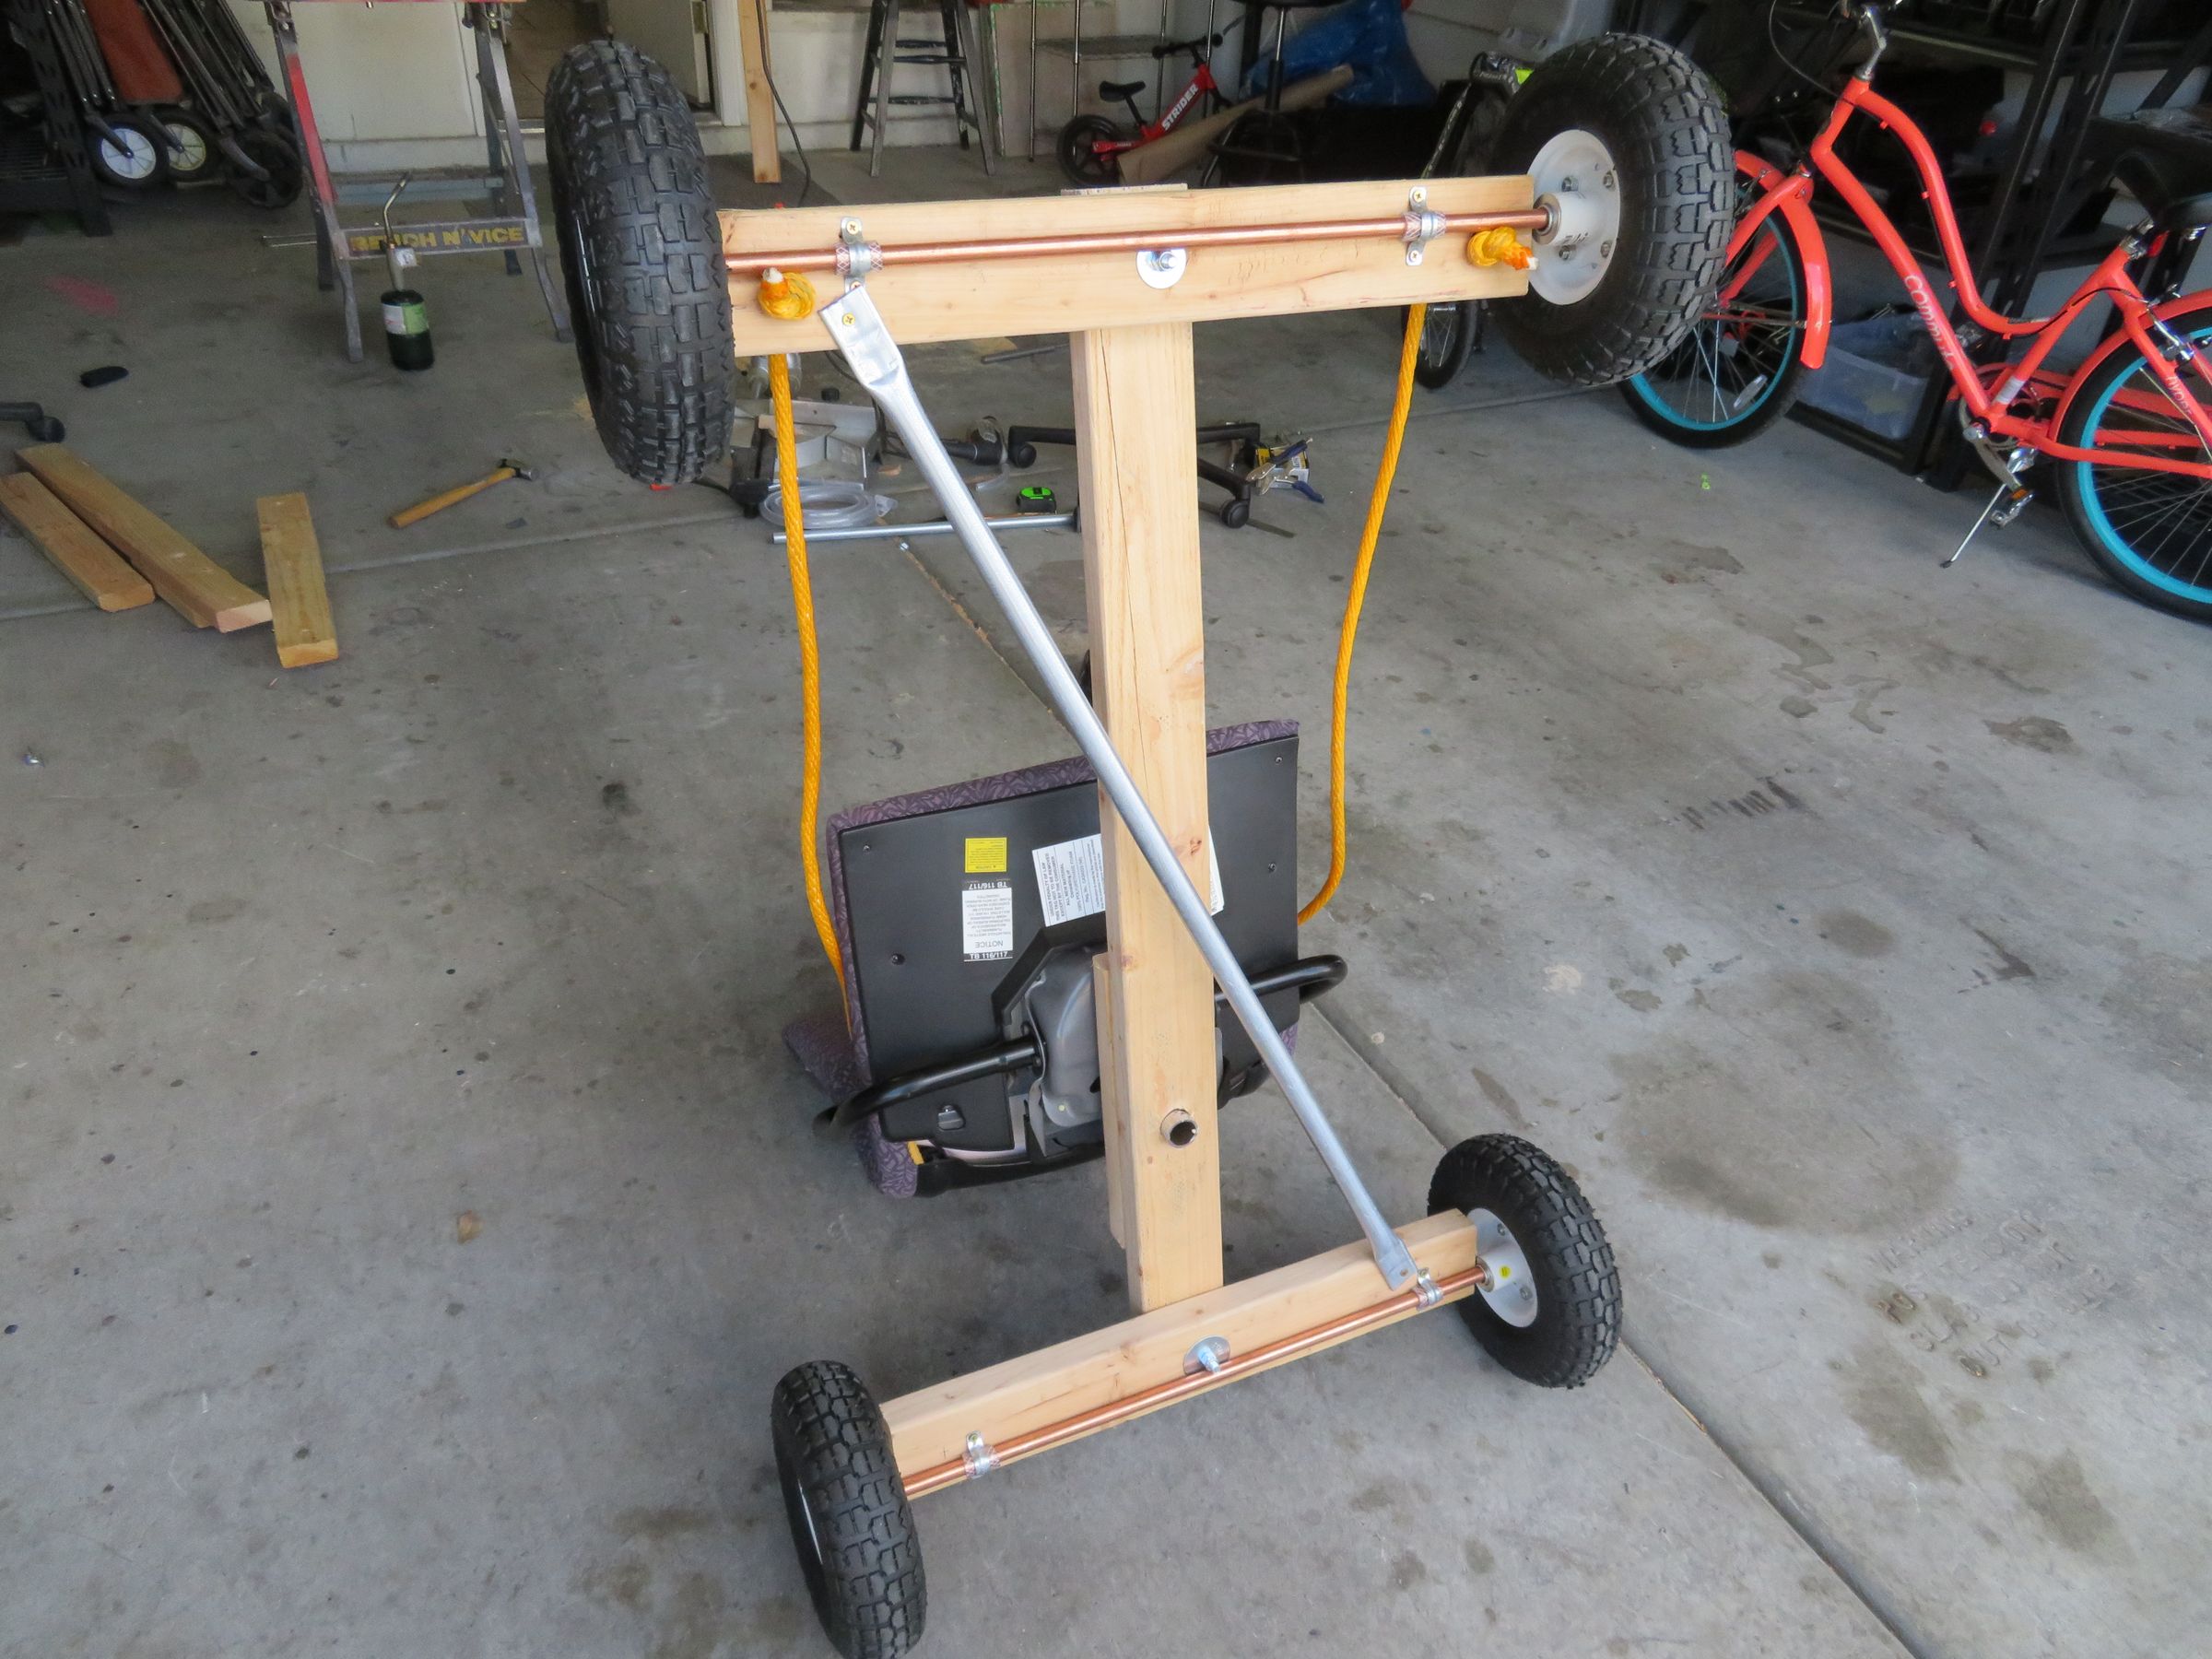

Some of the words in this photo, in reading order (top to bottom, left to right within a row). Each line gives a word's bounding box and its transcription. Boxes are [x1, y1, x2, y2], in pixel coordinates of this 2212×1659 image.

[1161, 83, 1199, 131] STRIDER
[467, 227, 524, 244] VICE
[975, 940, 1004, 948] NOTICE
